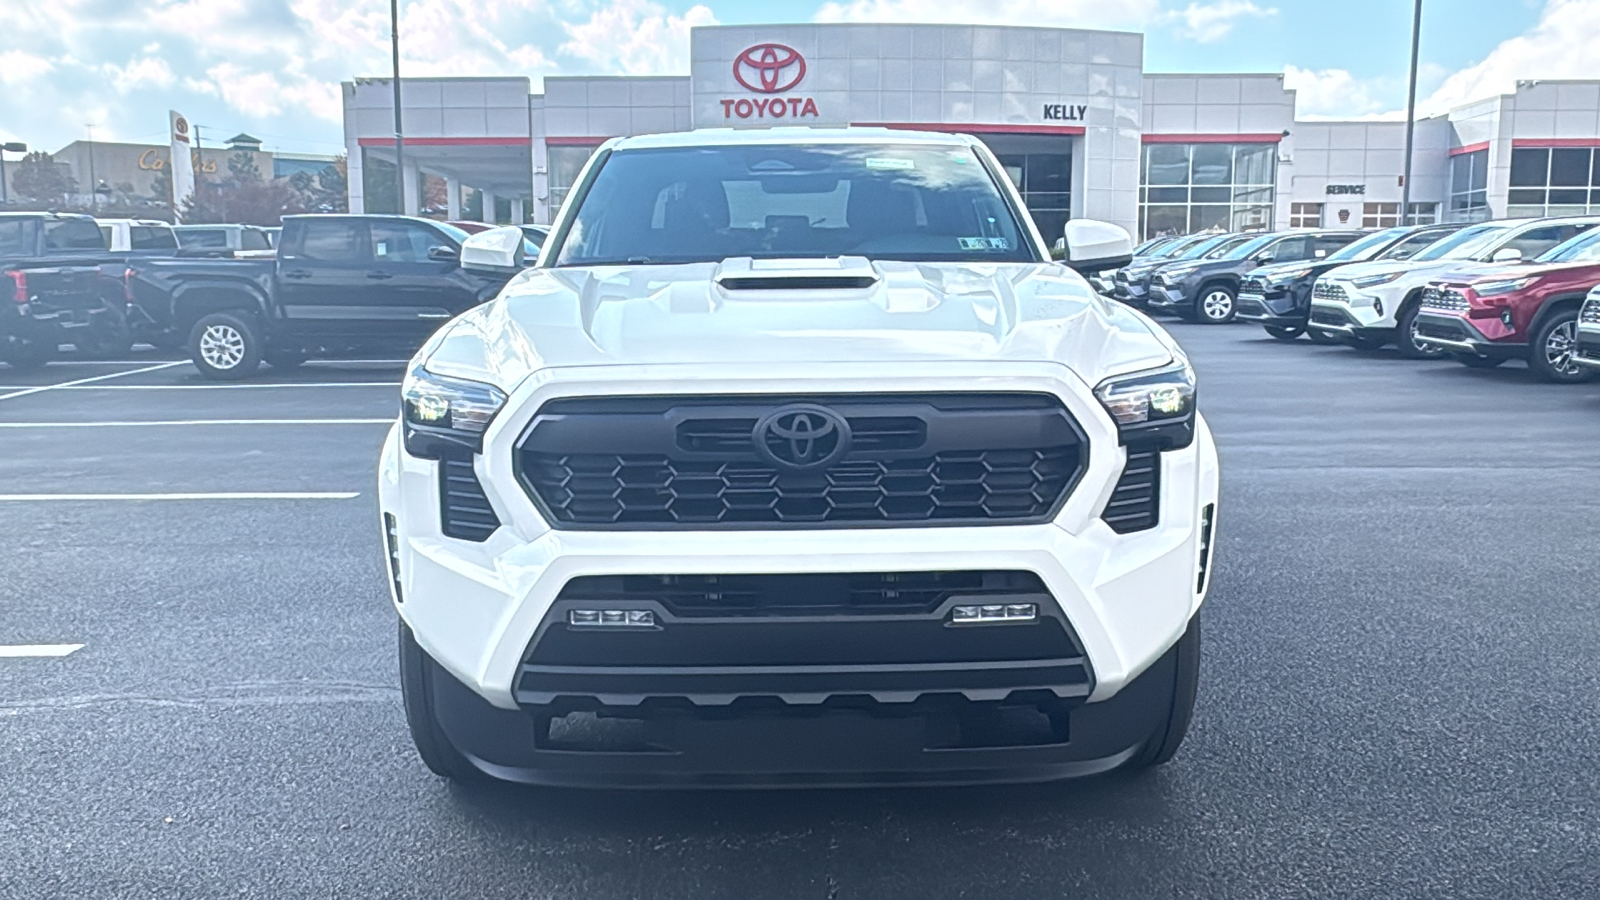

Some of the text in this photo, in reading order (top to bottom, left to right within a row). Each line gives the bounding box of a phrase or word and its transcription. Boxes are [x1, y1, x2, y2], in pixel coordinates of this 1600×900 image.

[720, 98, 819, 118] TOYOTA
[1043, 104, 1087, 121] KELLY
[1326, 184, 1366, 195] SERVICE
